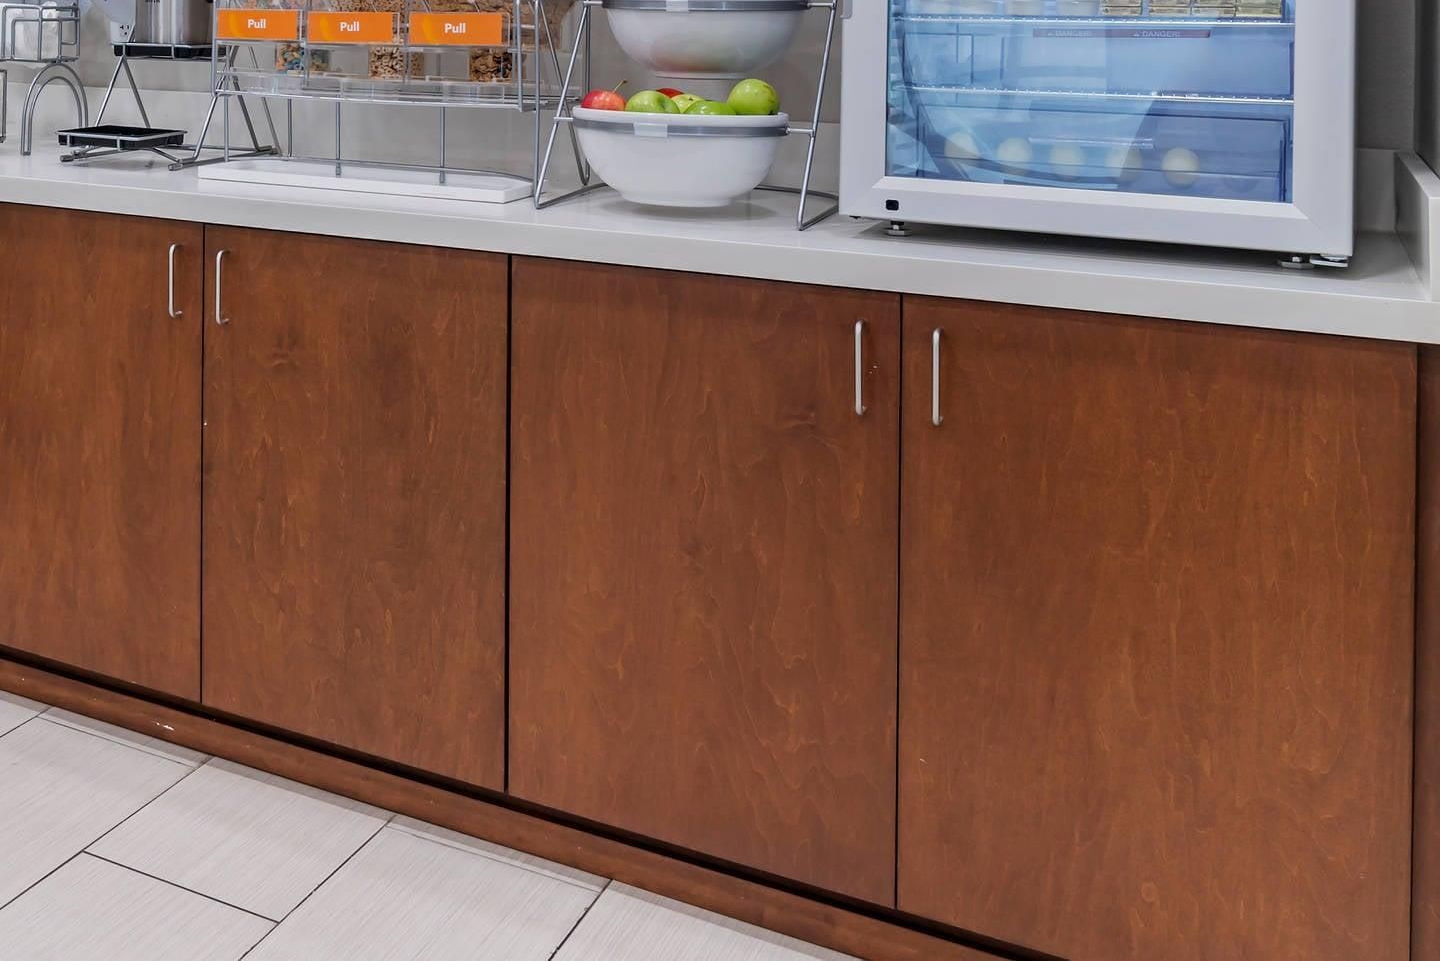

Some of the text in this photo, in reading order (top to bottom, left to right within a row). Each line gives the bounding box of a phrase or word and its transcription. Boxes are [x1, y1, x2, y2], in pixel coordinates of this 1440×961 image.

[247, 19, 267, 29] Pull
[340, 21, 360, 32] Pull
[444, 22, 466, 34] Pull
